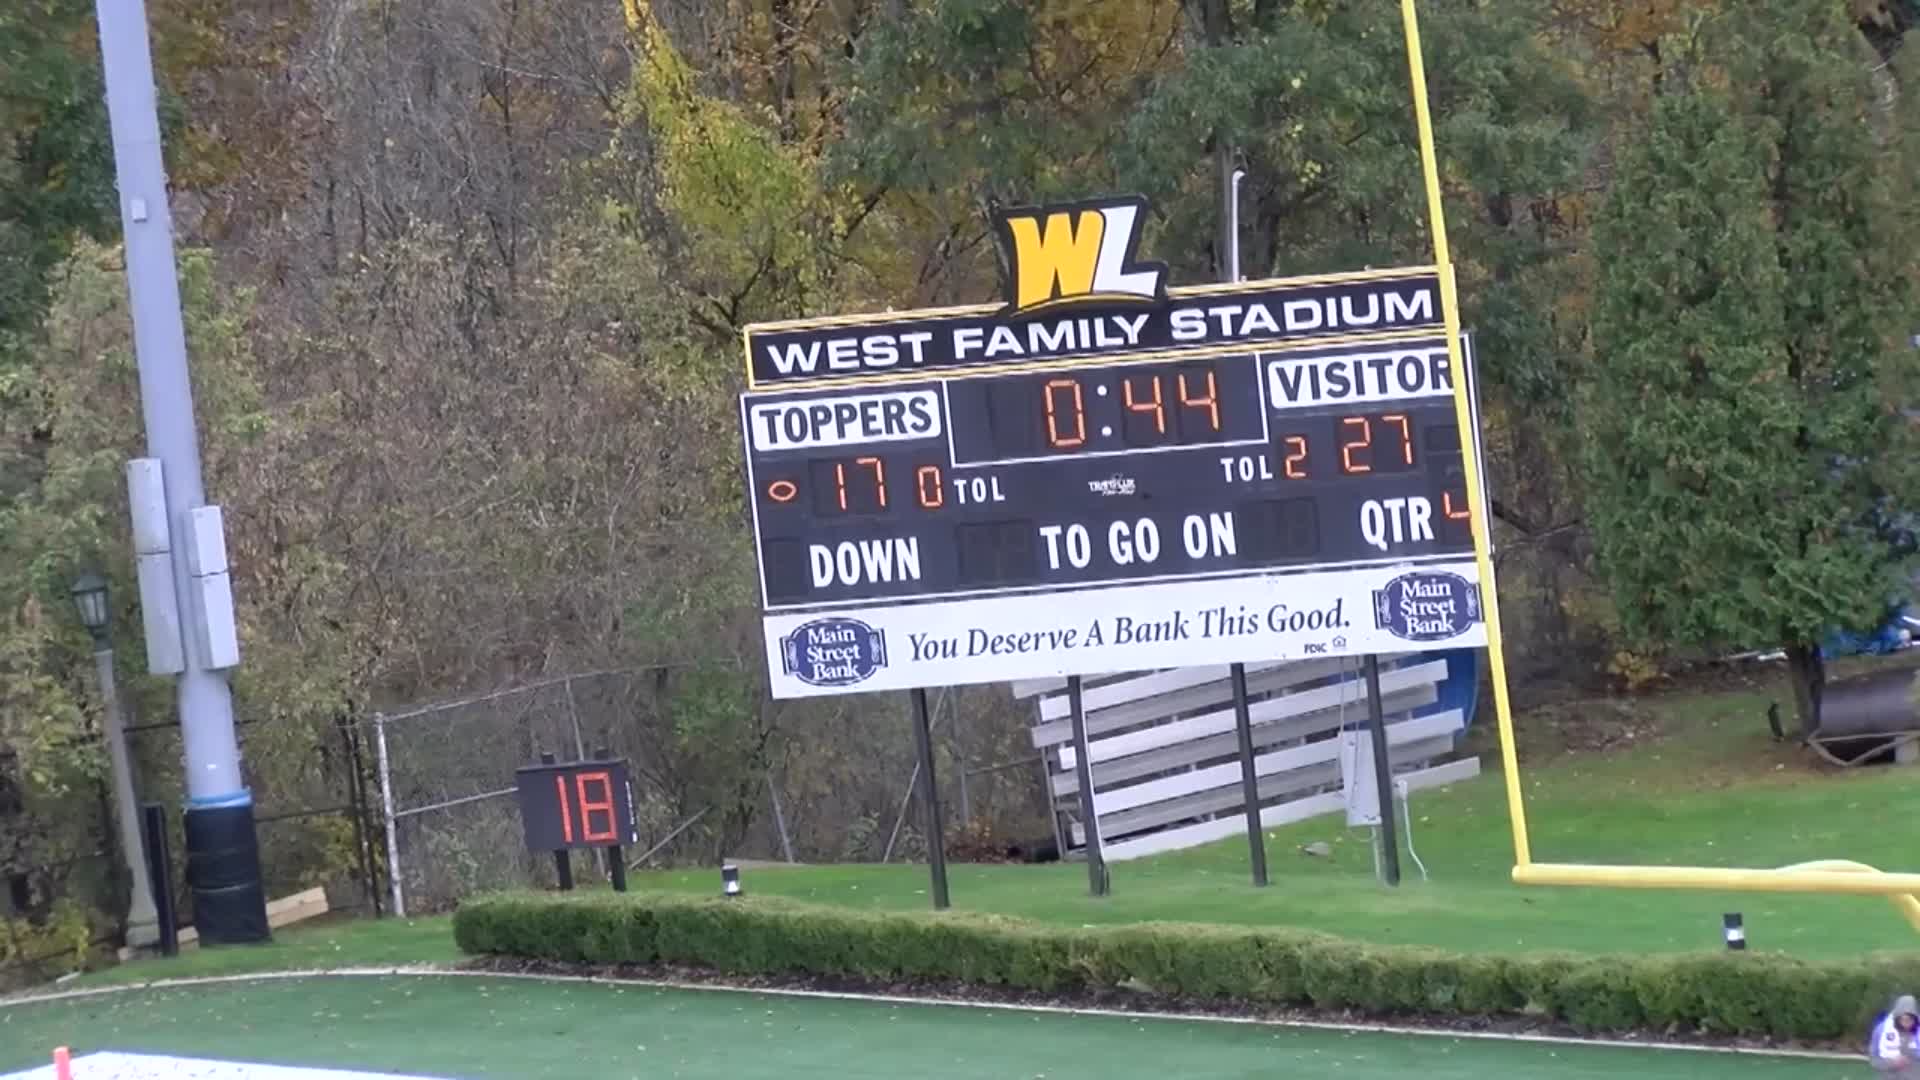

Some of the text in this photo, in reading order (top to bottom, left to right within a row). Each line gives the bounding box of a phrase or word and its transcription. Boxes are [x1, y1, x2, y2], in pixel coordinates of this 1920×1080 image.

[1008, 205, 1159, 308] WL
[767, 289, 1433, 374] WEST FAMILY STADIUM
[1275, 353, 1454, 402] VISITOR
[758, 396, 933, 445] TOPPERS
[1045, 371, 1220, 447] 0:44
[1284, 435, 1308, 478] 2
[1342, 414, 1414, 472] 27
[836, 456, 886, 510] 17
[917, 465, 944, 508] 0
[953, 476, 1006, 505] TOL
[1220, 455, 1273, 483] TOL
[1039, 511, 1238, 570] TO GO ON
[1360, 496, 1435, 551] QTR
[808, 536, 921, 588] DOWN
[1400, 578, 1452, 599] Main
[1400, 598, 1456, 617] Street
[807, 625, 856, 645] Main
[907, 598, 1351, 662] You Deserve A Bank This Good.
[1406, 611, 1456, 636] Bank
[806, 644, 861, 664] Street
[813, 660, 862, 681] Bank
[556, 771, 618, 843] 18
